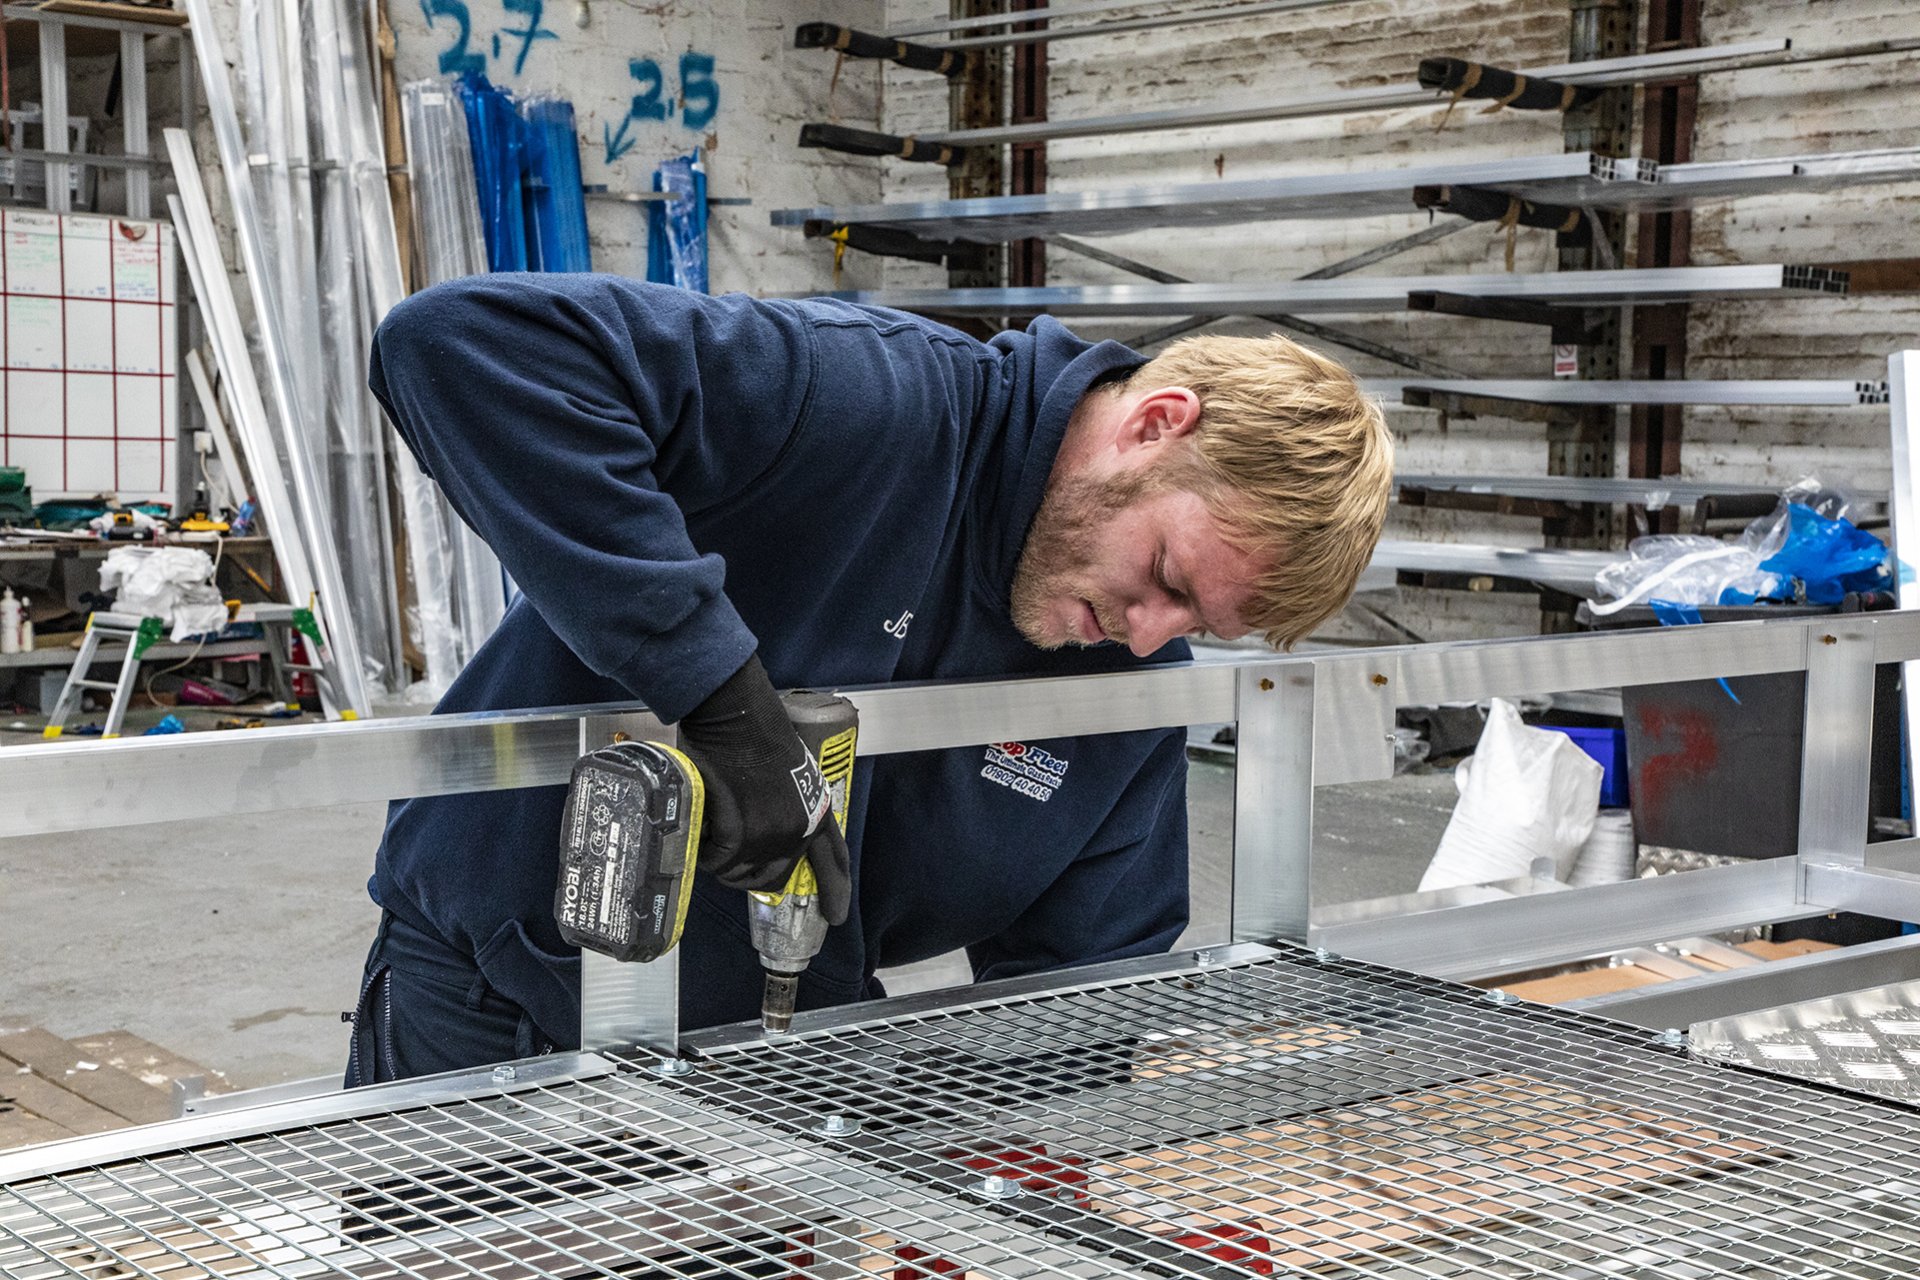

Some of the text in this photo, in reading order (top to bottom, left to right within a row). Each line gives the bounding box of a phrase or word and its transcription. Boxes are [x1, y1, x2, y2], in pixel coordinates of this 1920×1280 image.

[984, 764, 1014, 785] 01902
[985, 749, 1000, 762] The
[999, 755, 1026, 772] Ultimate
[1026, 767, 1045, 781] Glass
[1025, 747, 1067, 774] Fleet
[562, 866, 581, 924] RYOBI
[588, 865, 602, 929] 24Wh (1.3Ah)
